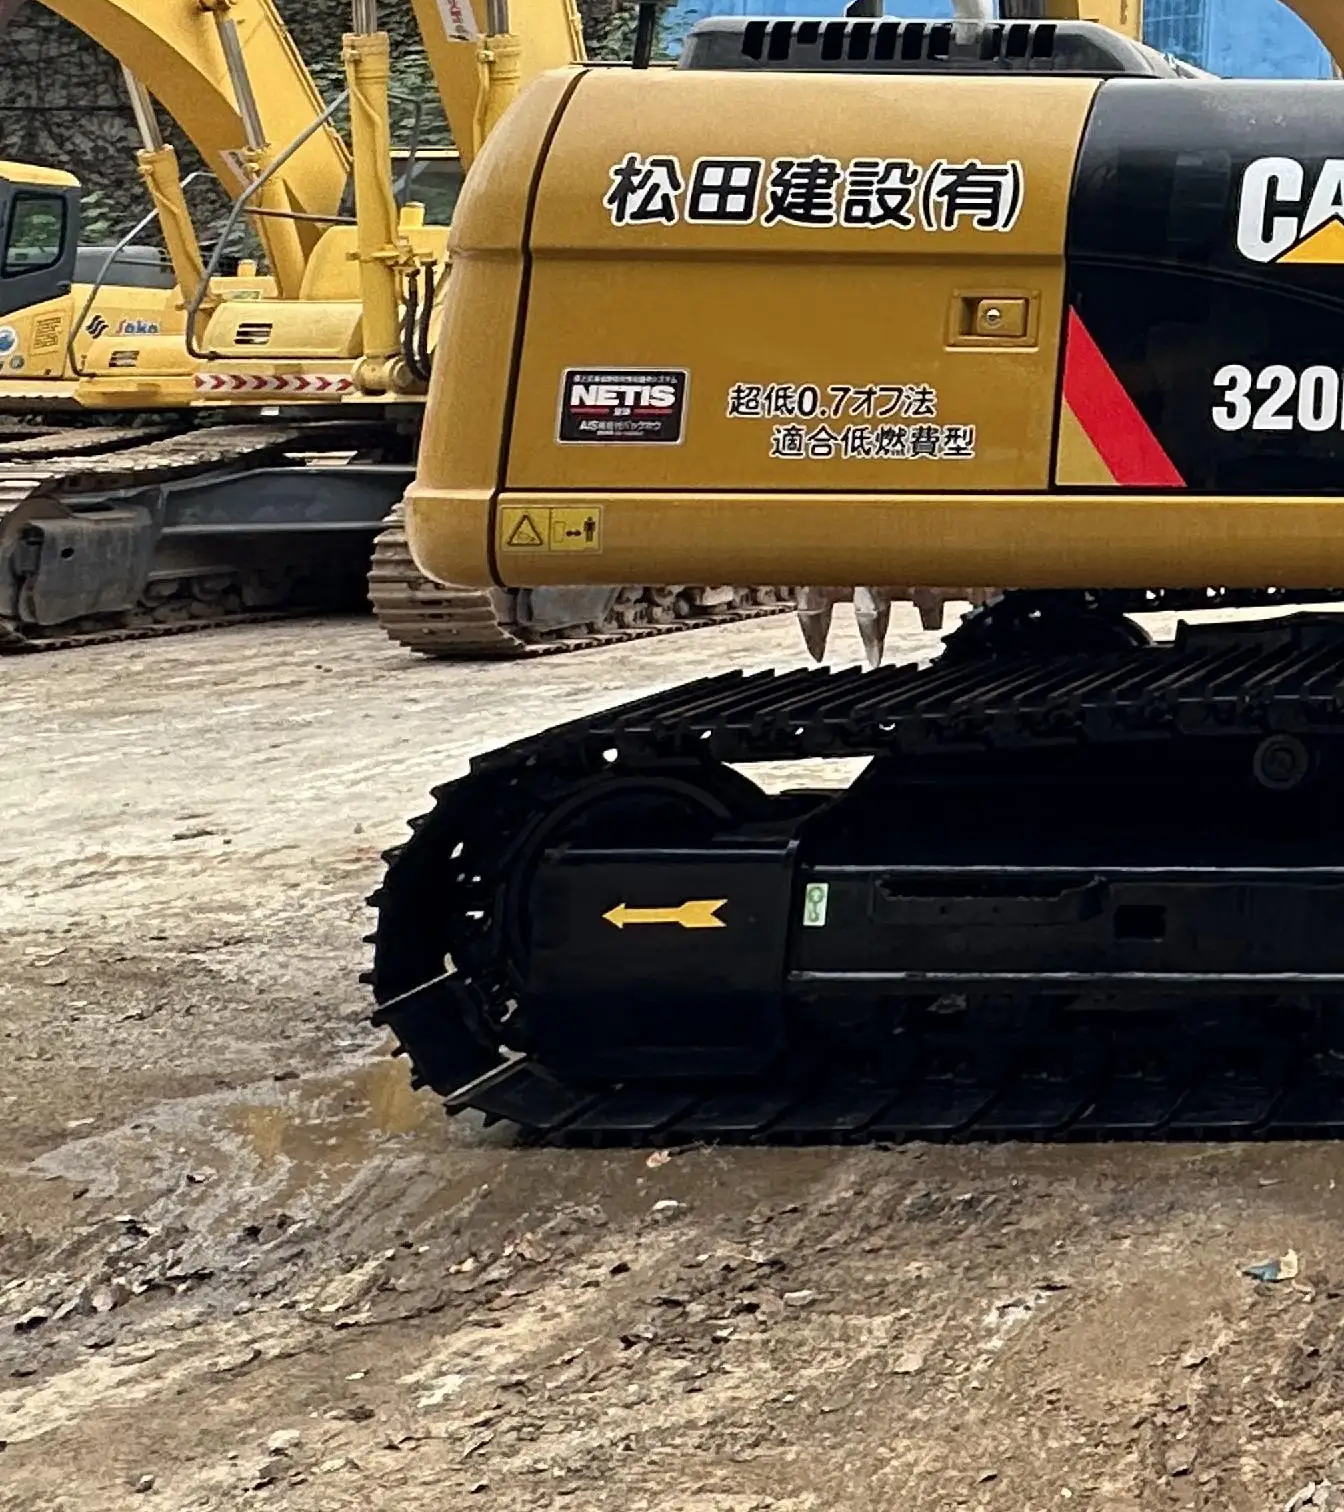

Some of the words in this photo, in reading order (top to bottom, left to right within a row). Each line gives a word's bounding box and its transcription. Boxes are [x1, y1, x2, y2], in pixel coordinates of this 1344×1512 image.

[604, 153, 1024, 230] 松田建設(有)
[569, 384, 676, 408] NETIS
[727, 382, 939, 418] 超低0.7オフ法
[769, 421, 977, 460] 適合低燃費型
